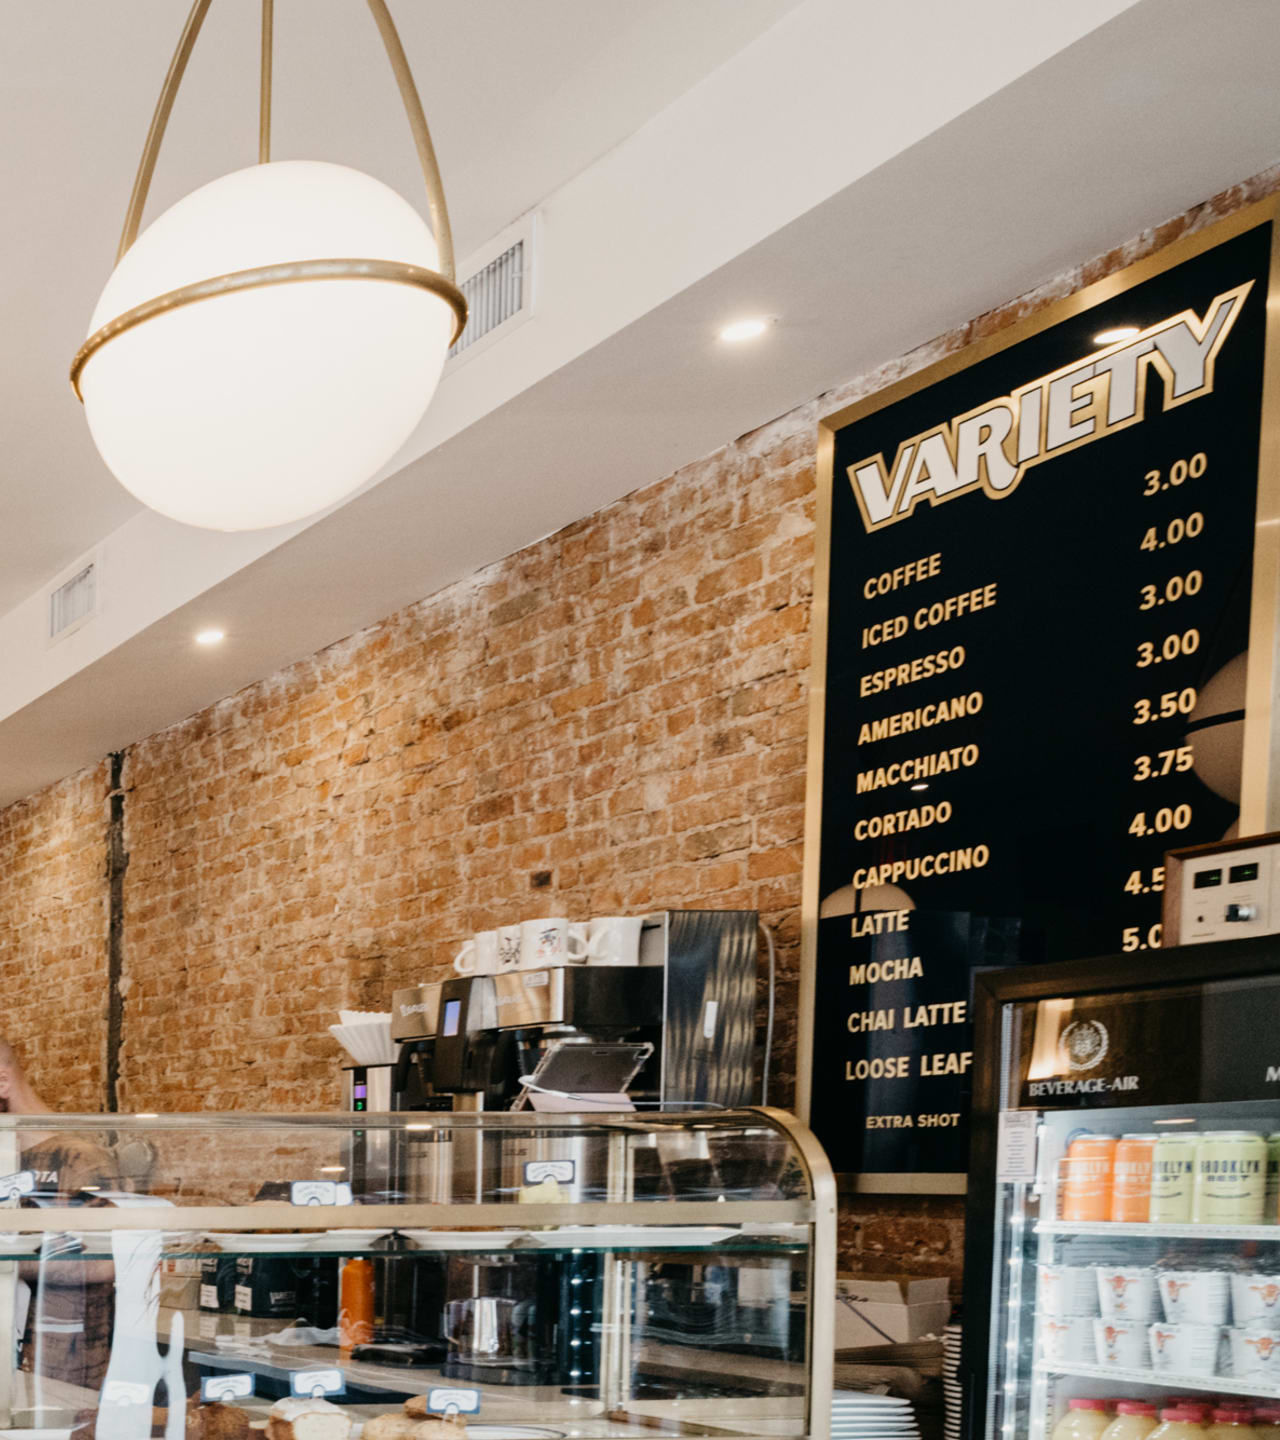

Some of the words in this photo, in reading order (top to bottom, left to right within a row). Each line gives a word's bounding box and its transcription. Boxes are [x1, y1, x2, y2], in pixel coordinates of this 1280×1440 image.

[847, 279, 1256, 534] VARIETY
[1143, 452, 1207, 496] 3.00
[1140, 511, 1204, 552] 4.00
[863, 552, 942, 600] COFFEE
[1139, 570, 1203, 610] 3.00
[861, 615, 909, 649] ICED
[913, 583, 997, 631] COFFEE
[1136, 628, 1200, 668] 3.00
[859, 645, 966, 698] ESPRESSO
[857, 691, 984, 746] AMERICANO
[1132, 687, 1197, 725] 3.50
[855, 743, 980, 795] MACCHIATO
[1132, 745, 1195, 781] 3.75
[853, 801, 953, 841] CORTADO
[1128, 804, 1192, 837] 4.00
[852, 844, 990, 890] CAPPUCCINO
[850, 908, 910, 938] LATTE
[848, 956, 924, 986] MOCHA
[846, 1008, 895, 1034] CHAI
[903, 1000, 967, 1029] LATTE
[845, 1055, 910, 1081] LOOSE
[920, 1051, 974, 1077] LEAF
[1028, 1075, 1140, 1097] BEVERAGE-AIR
[865, 1114, 914, 1130] EXTRA
[916, 1112, 961, 1128] SHOT
